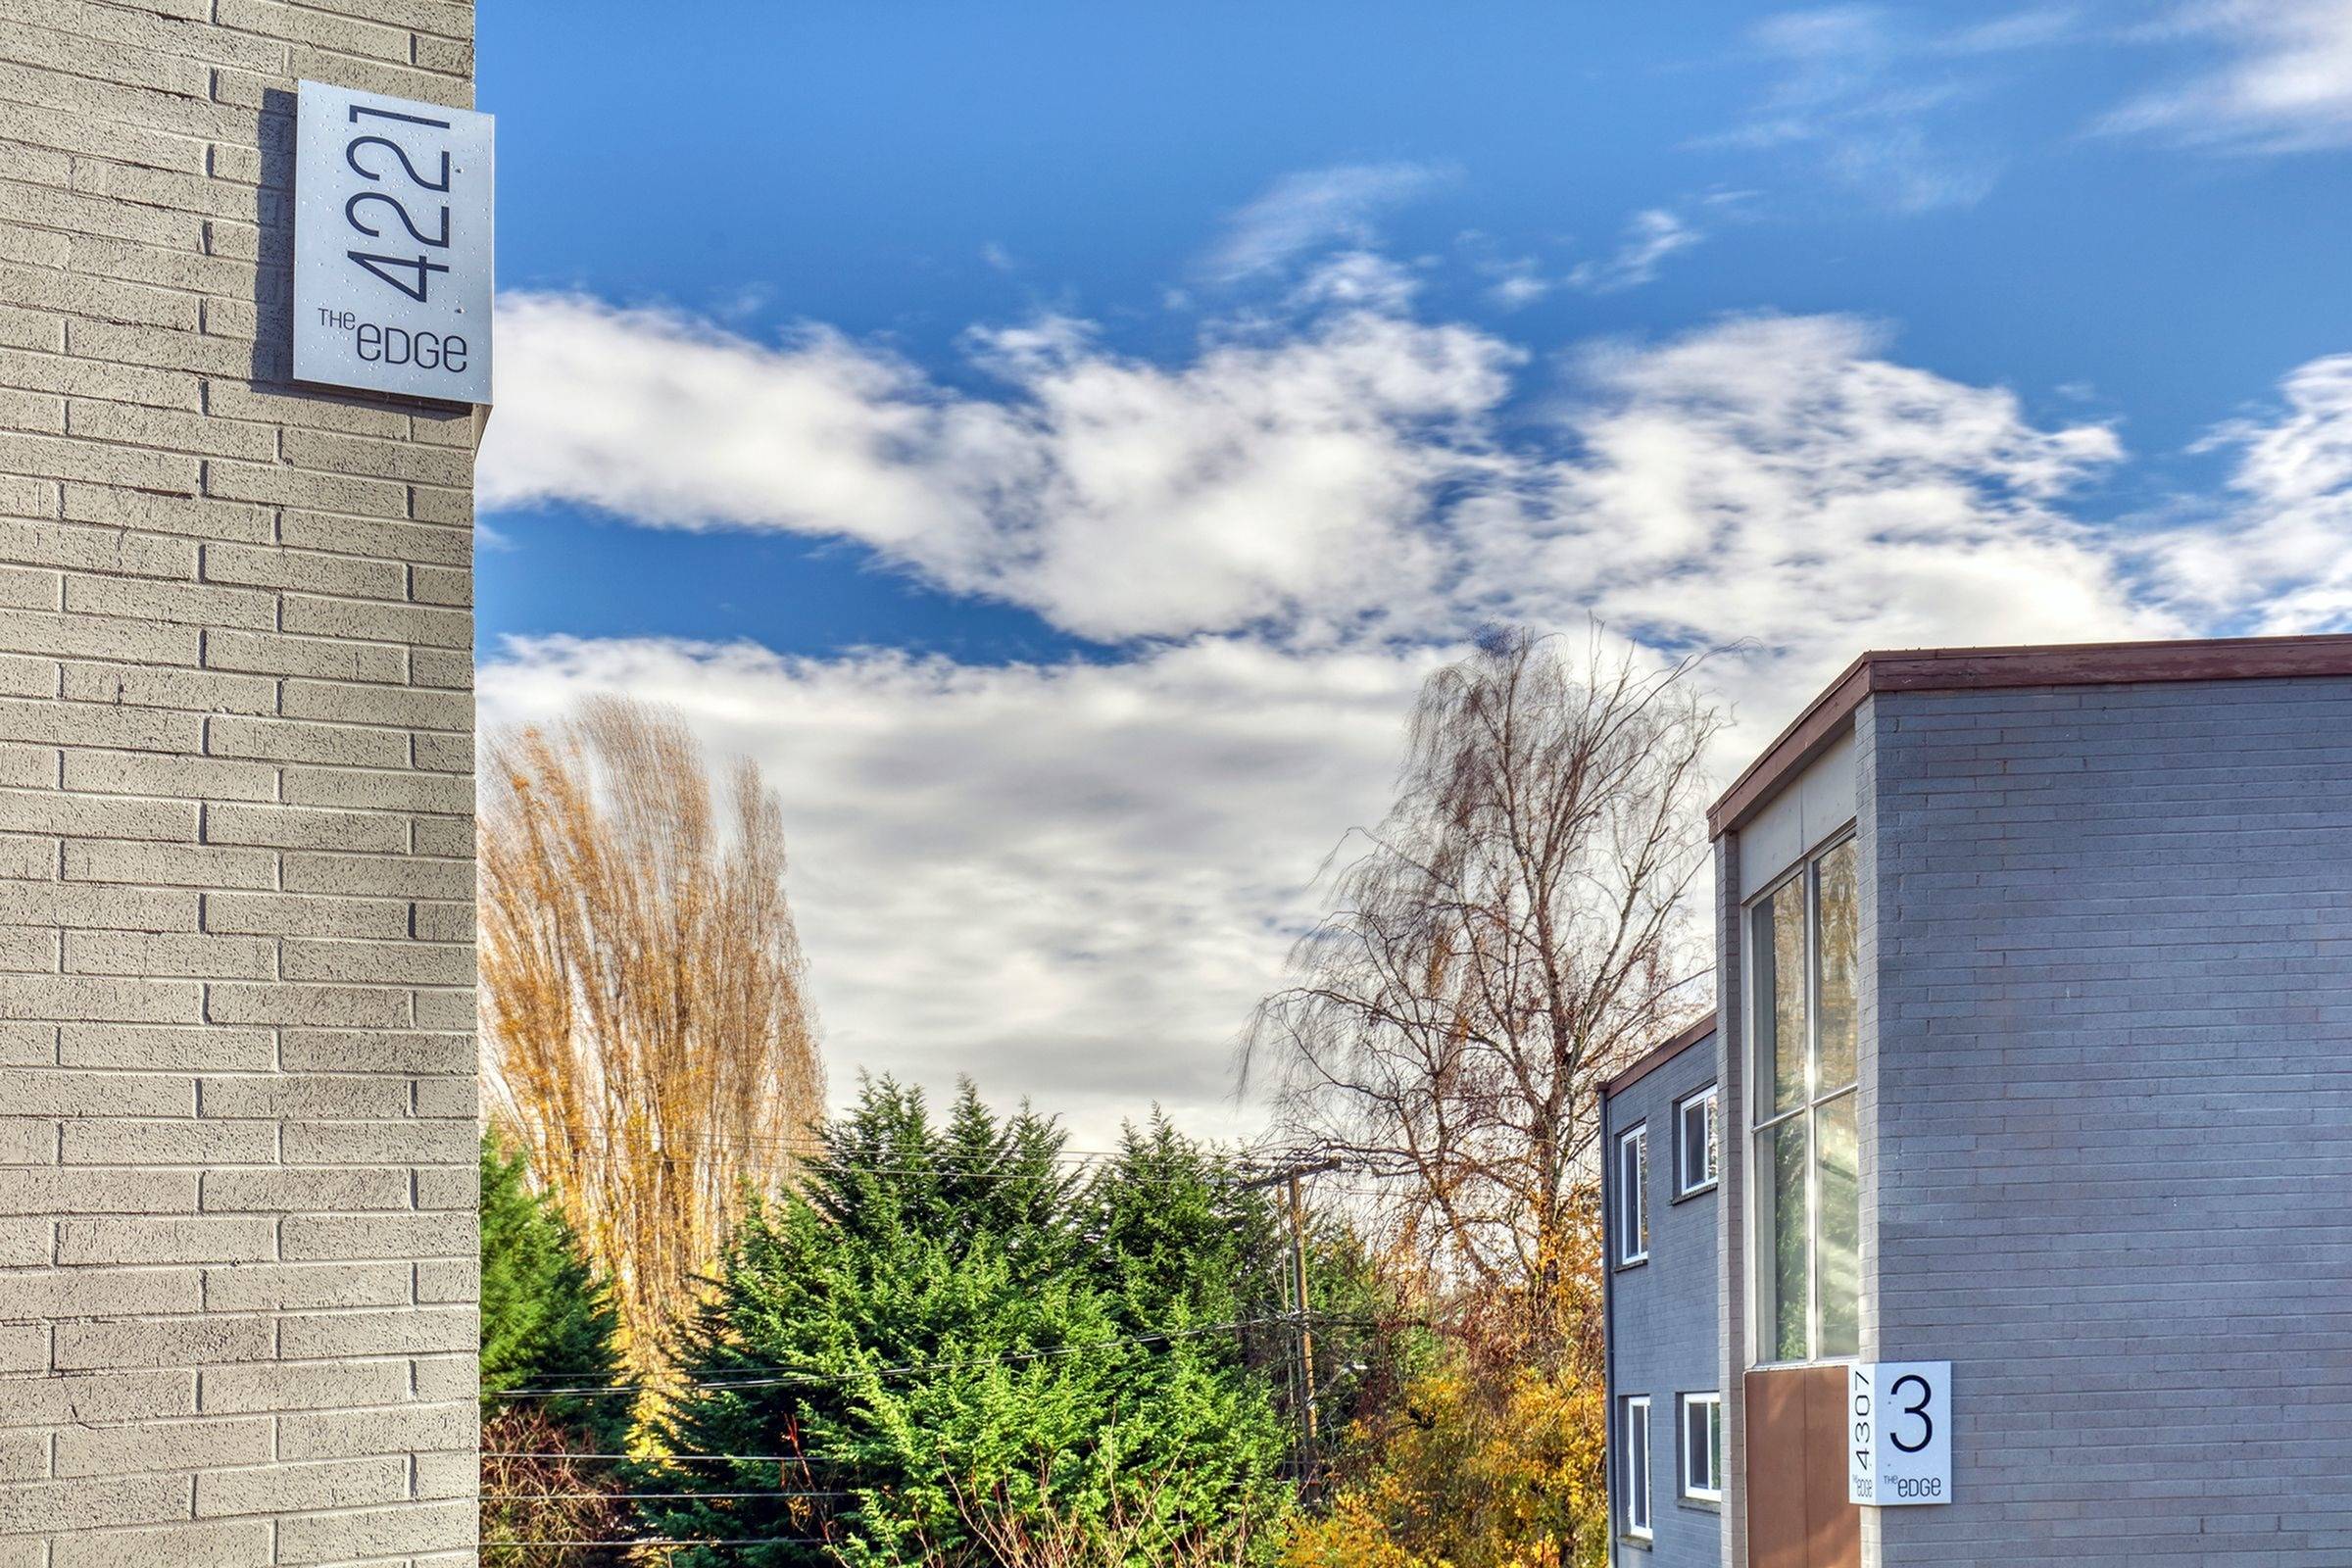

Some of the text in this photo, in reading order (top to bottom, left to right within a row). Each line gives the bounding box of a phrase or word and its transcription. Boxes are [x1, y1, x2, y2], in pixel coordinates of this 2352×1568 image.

[345, 104, 451, 304] 4221
[1854, 1370, 1871, 1470] 4307
[1889, 1374, 1933, 1453] 3
